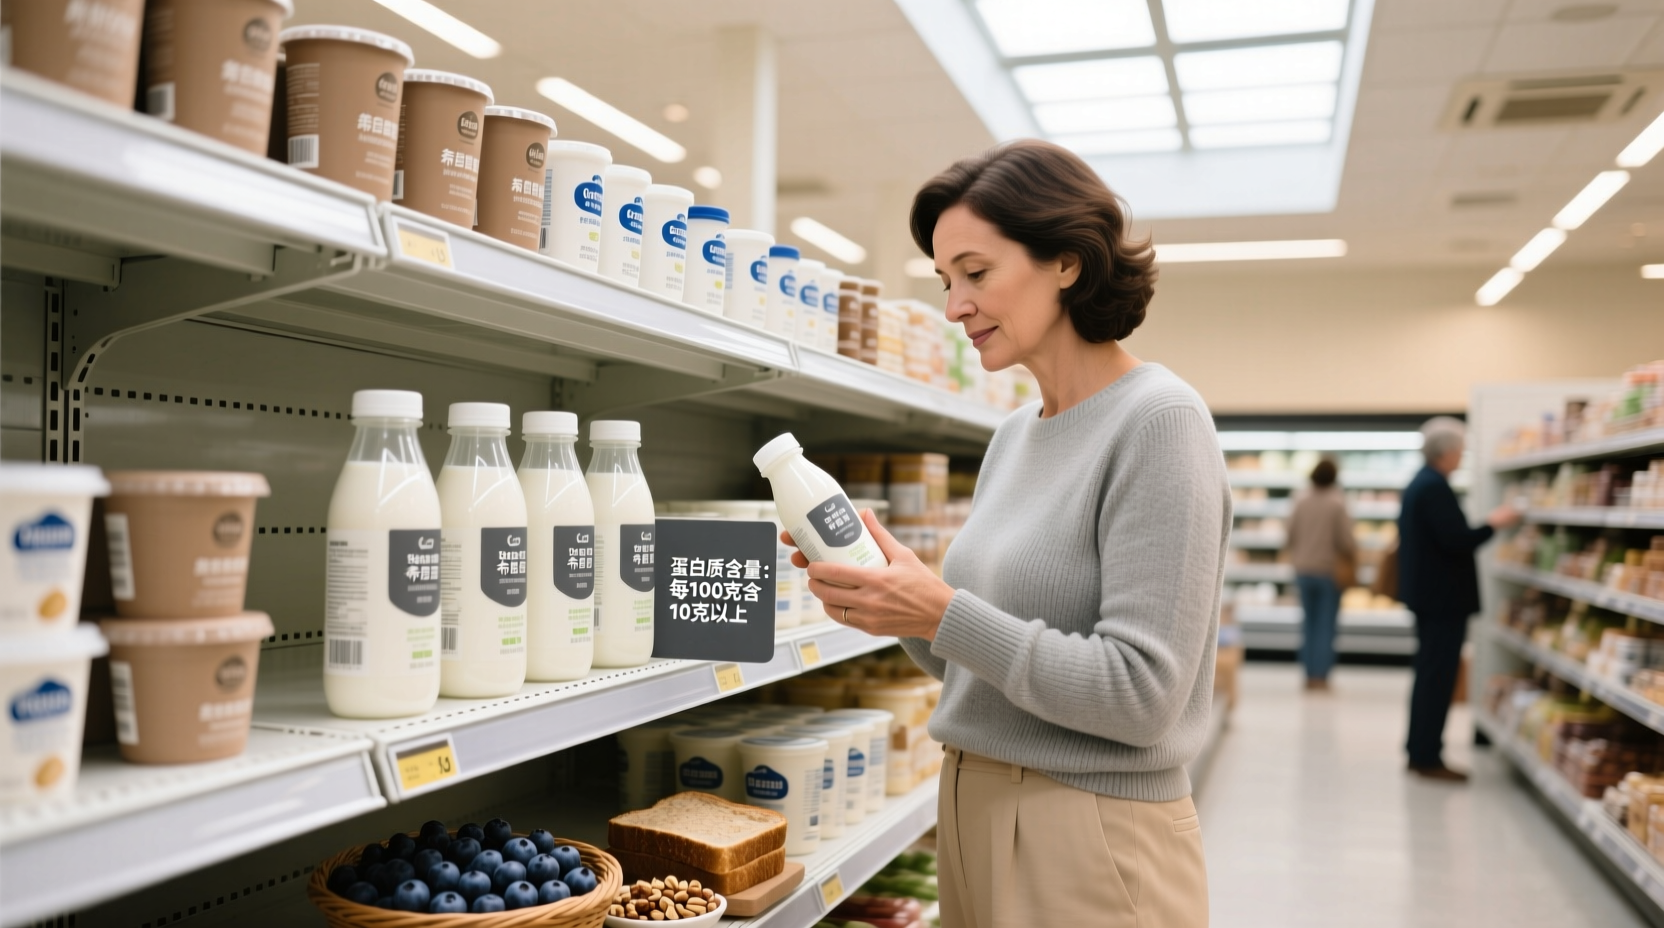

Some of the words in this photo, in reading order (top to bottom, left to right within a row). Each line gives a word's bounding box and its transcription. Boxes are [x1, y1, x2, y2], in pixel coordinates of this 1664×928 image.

[670, 556, 769, 579] 蛋白质含量：
[669, 578, 763, 602] 每100克含
[669, 601, 748, 623] 10克以上
